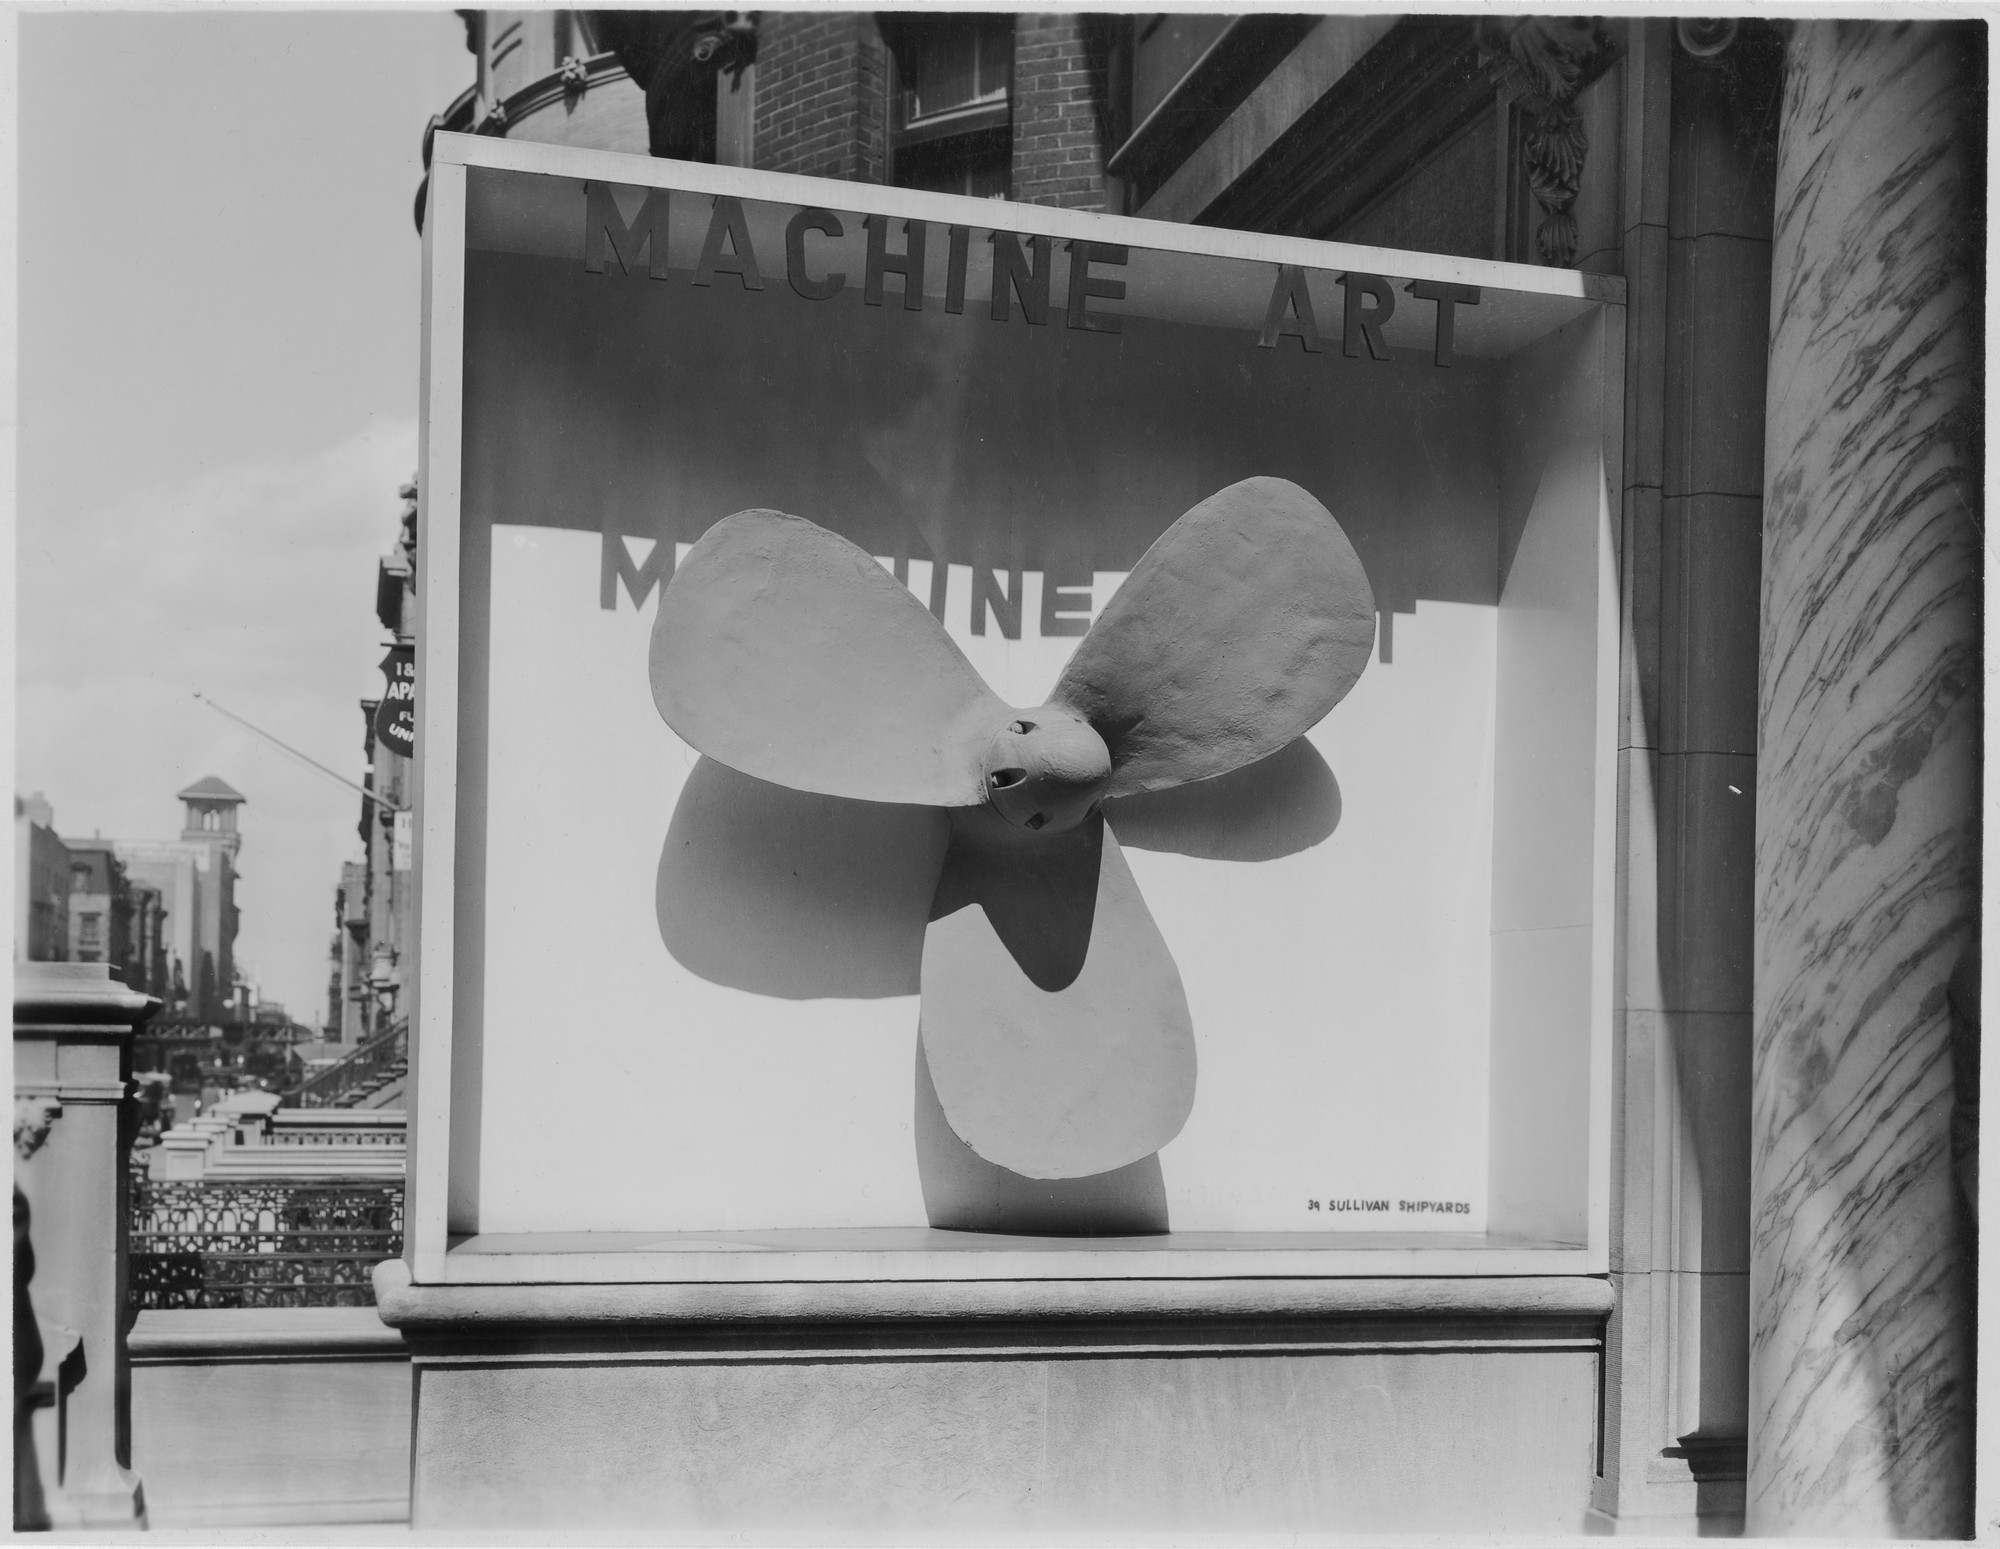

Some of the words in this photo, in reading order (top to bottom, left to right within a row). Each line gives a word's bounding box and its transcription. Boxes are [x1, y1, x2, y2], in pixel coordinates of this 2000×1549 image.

[584, 179, 1130, 333] MACHINE
[1257, 263, 1481, 368] ART
[1307, 1199, 1320, 1212] 39
[1328, 1199, 1390, 1212] SULLIVAN
[1398, 1199, 1471, 1215] SHIPYARDS
